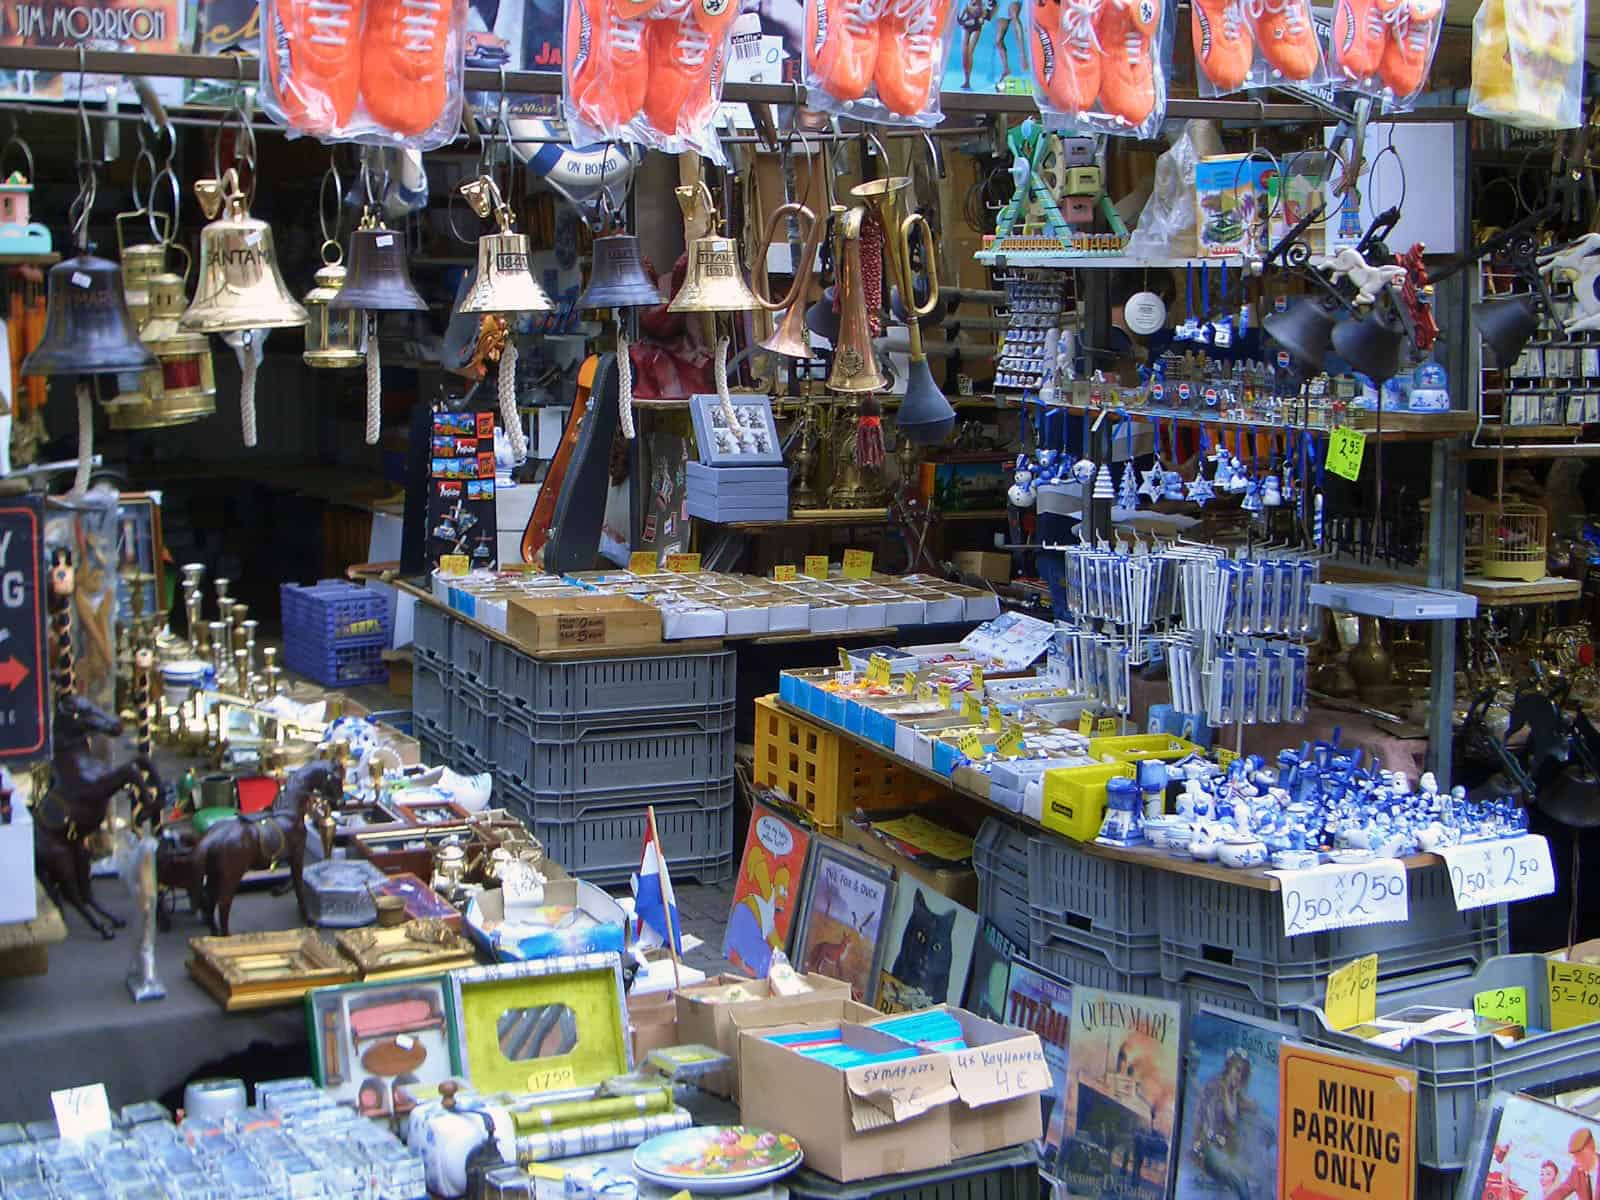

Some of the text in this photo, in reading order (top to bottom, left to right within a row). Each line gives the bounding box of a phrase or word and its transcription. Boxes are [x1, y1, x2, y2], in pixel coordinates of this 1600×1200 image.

[16, 4, 166, 41] JIM MORRISON
[567, 157, 617, 176] ON BOARD
[860, 882, 878, 899] DUCK
[1080, 999, 1175, 1043] QUEEN MARY
[1318, 1079, 1374, 1122] MINI
[1292, 1107, 1401, 1165] PARKING
[1314, 1149, 1376, 1194] ONLY
